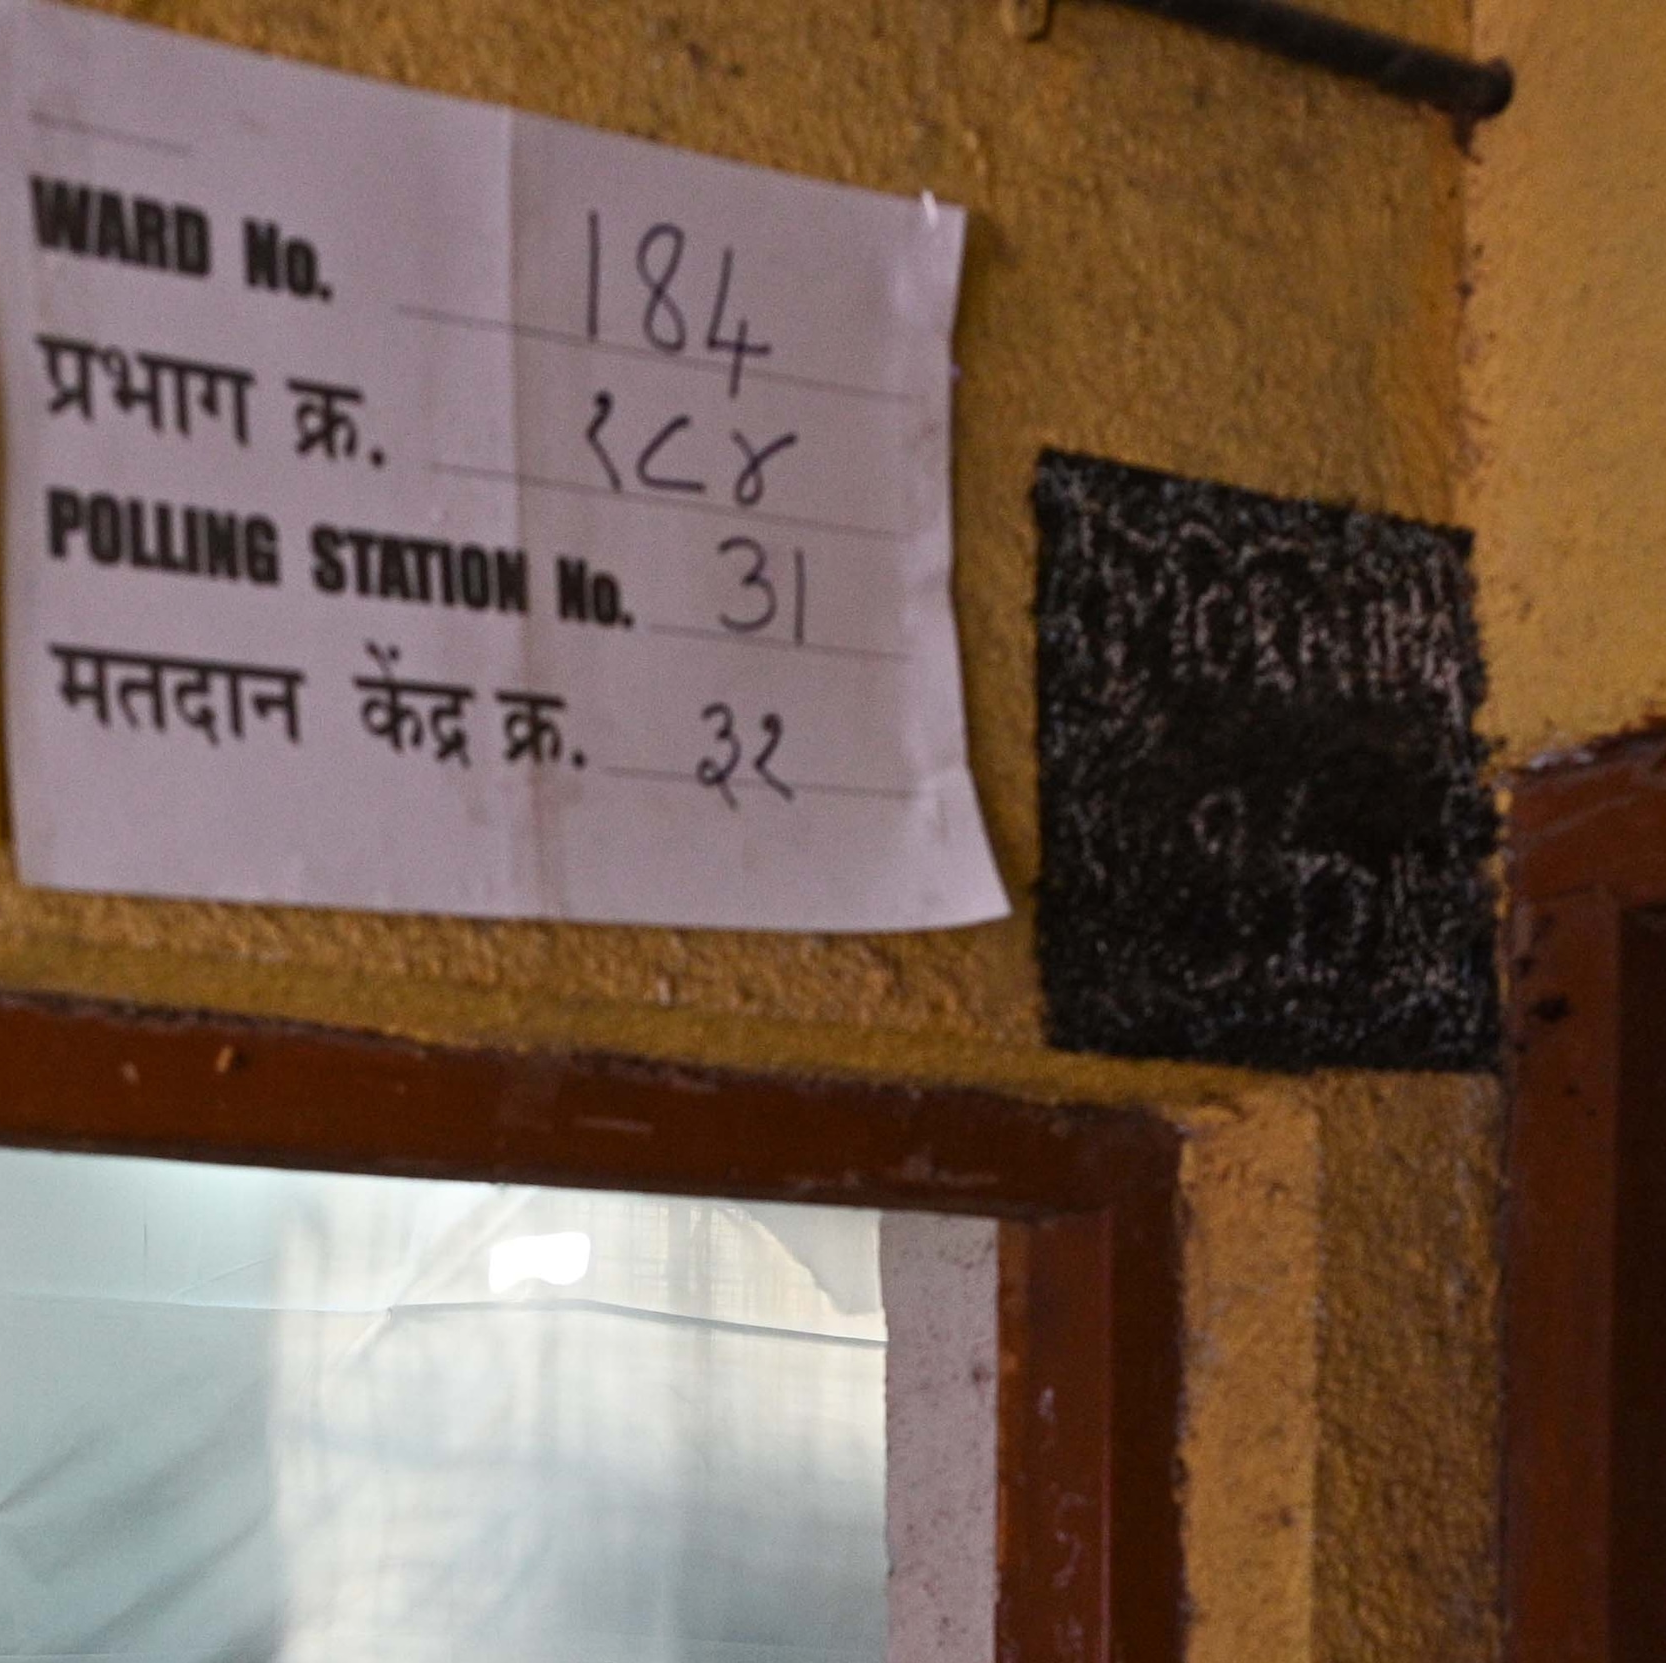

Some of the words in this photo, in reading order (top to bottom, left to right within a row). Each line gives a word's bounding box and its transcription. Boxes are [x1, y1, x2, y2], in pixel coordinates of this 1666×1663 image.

[30, 172, 210, 277] WARD
[244, 215, 332, 301] No.
[587, 209, 772, 398] 184
[35, 332, 254, 450] प्रभाग
[288, 373, 387, 469] क्र.
[47, 488, 279, 587] POLLING
[310, 523, 529, 614] STATION
[556, 556, 635, 630] No.
[717, 537, 805, 646] 31
[49, 642, 303, 744] मतदान
[354, 644, 472, 769] केंद्र
[497, 691, 587, 771] क्र.
